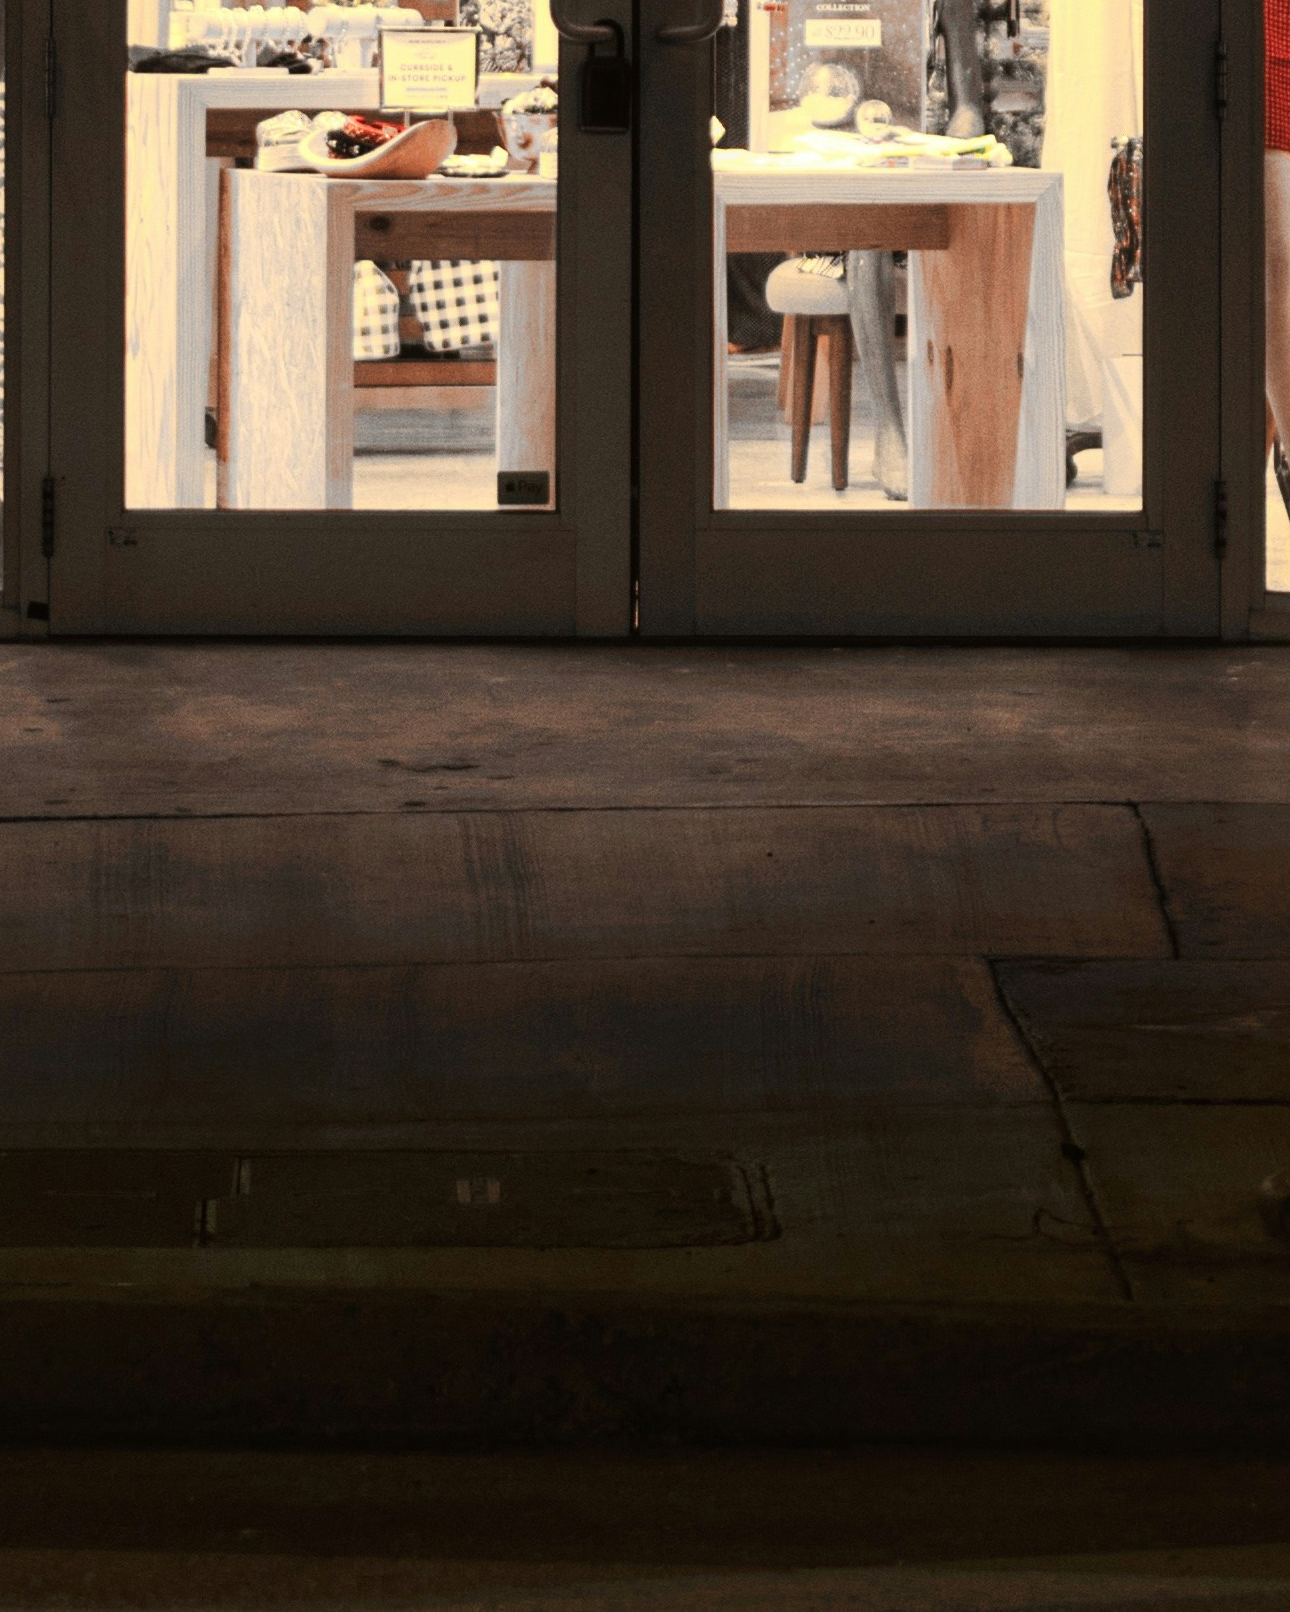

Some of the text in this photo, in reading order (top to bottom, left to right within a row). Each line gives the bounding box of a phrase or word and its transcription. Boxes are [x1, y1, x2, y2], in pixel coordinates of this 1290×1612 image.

[816, 3, 871, 11] COLLECTION
[400, 63, 443, 71] CURBSIDE
[433, 74, 466, 82] PICKUP
